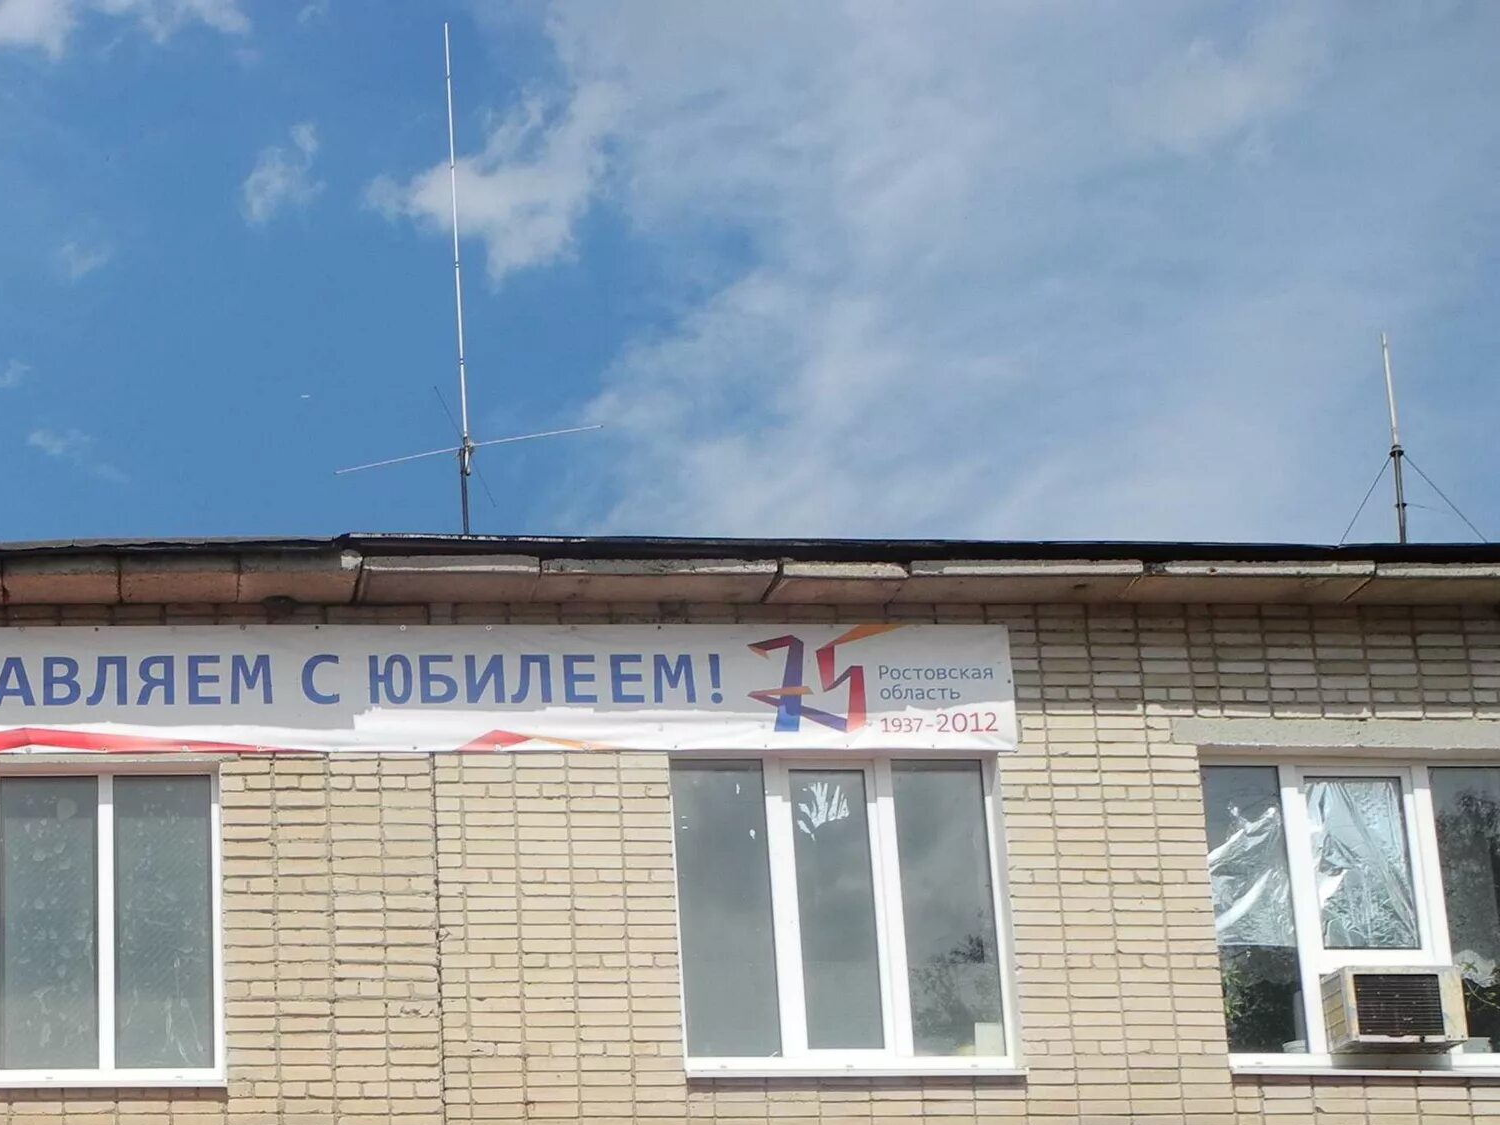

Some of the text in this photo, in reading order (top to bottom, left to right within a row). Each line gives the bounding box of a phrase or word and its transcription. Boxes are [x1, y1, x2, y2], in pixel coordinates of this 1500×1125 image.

[301, 654, 341, 704] С
[368, 653, 724, 705] ЮБИЛЕЕМ!
[878, 664, 994, 681] Ростовская
[879, 683, 962, 701] область
